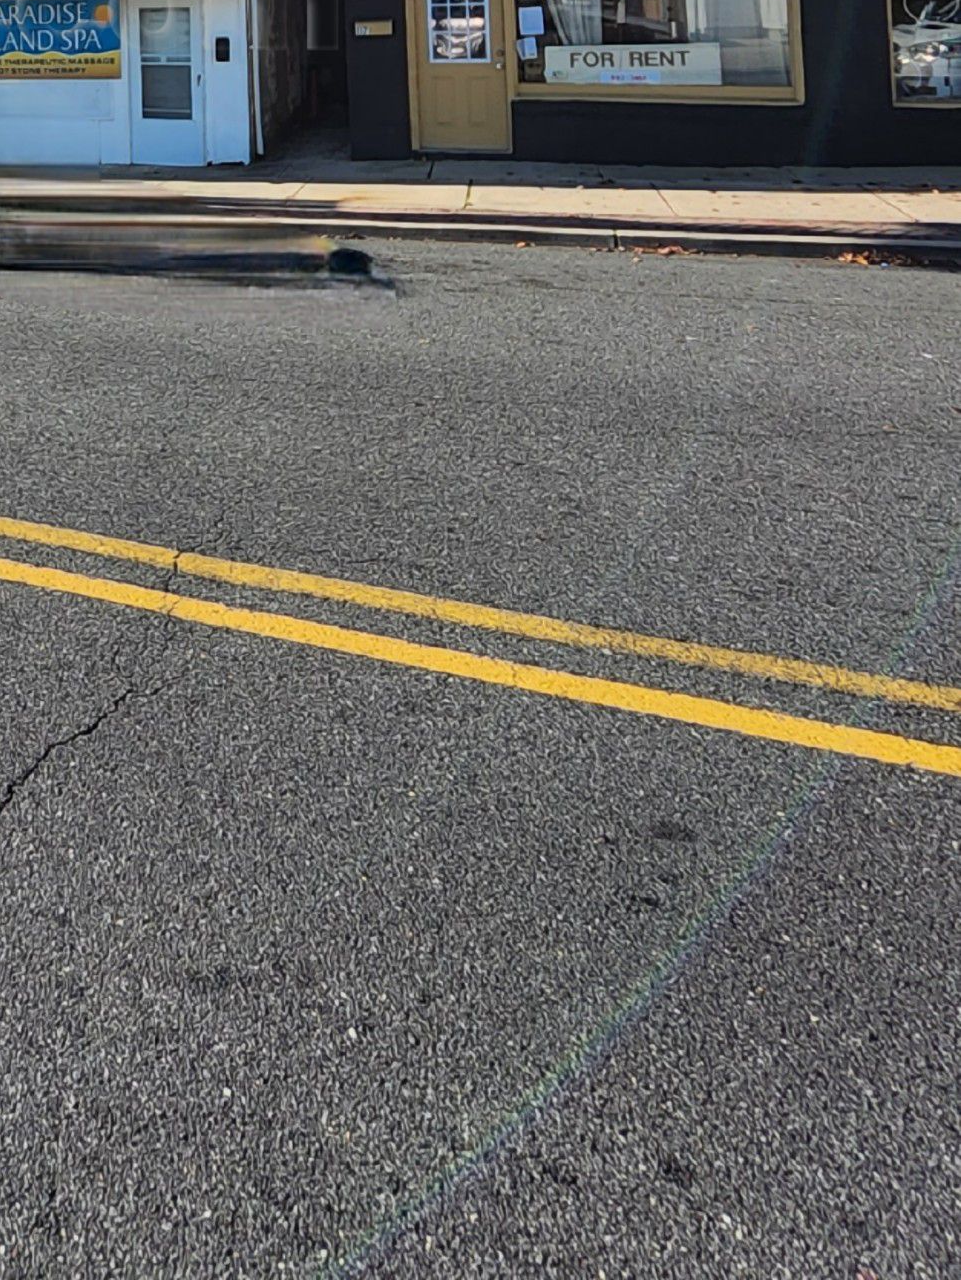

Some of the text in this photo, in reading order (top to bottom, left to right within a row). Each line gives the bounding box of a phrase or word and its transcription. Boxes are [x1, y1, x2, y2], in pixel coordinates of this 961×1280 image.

[60, 27, 101, 51] SPA
[4, 57, 66, 66] THERAPEUTIC
[68, 56, 115, 65] MASSAGE
[569, 50, 691, 68] FOR RENT
[12, 66, 42, 75] STONE
[44, 66, 87, 74] THERAPY
